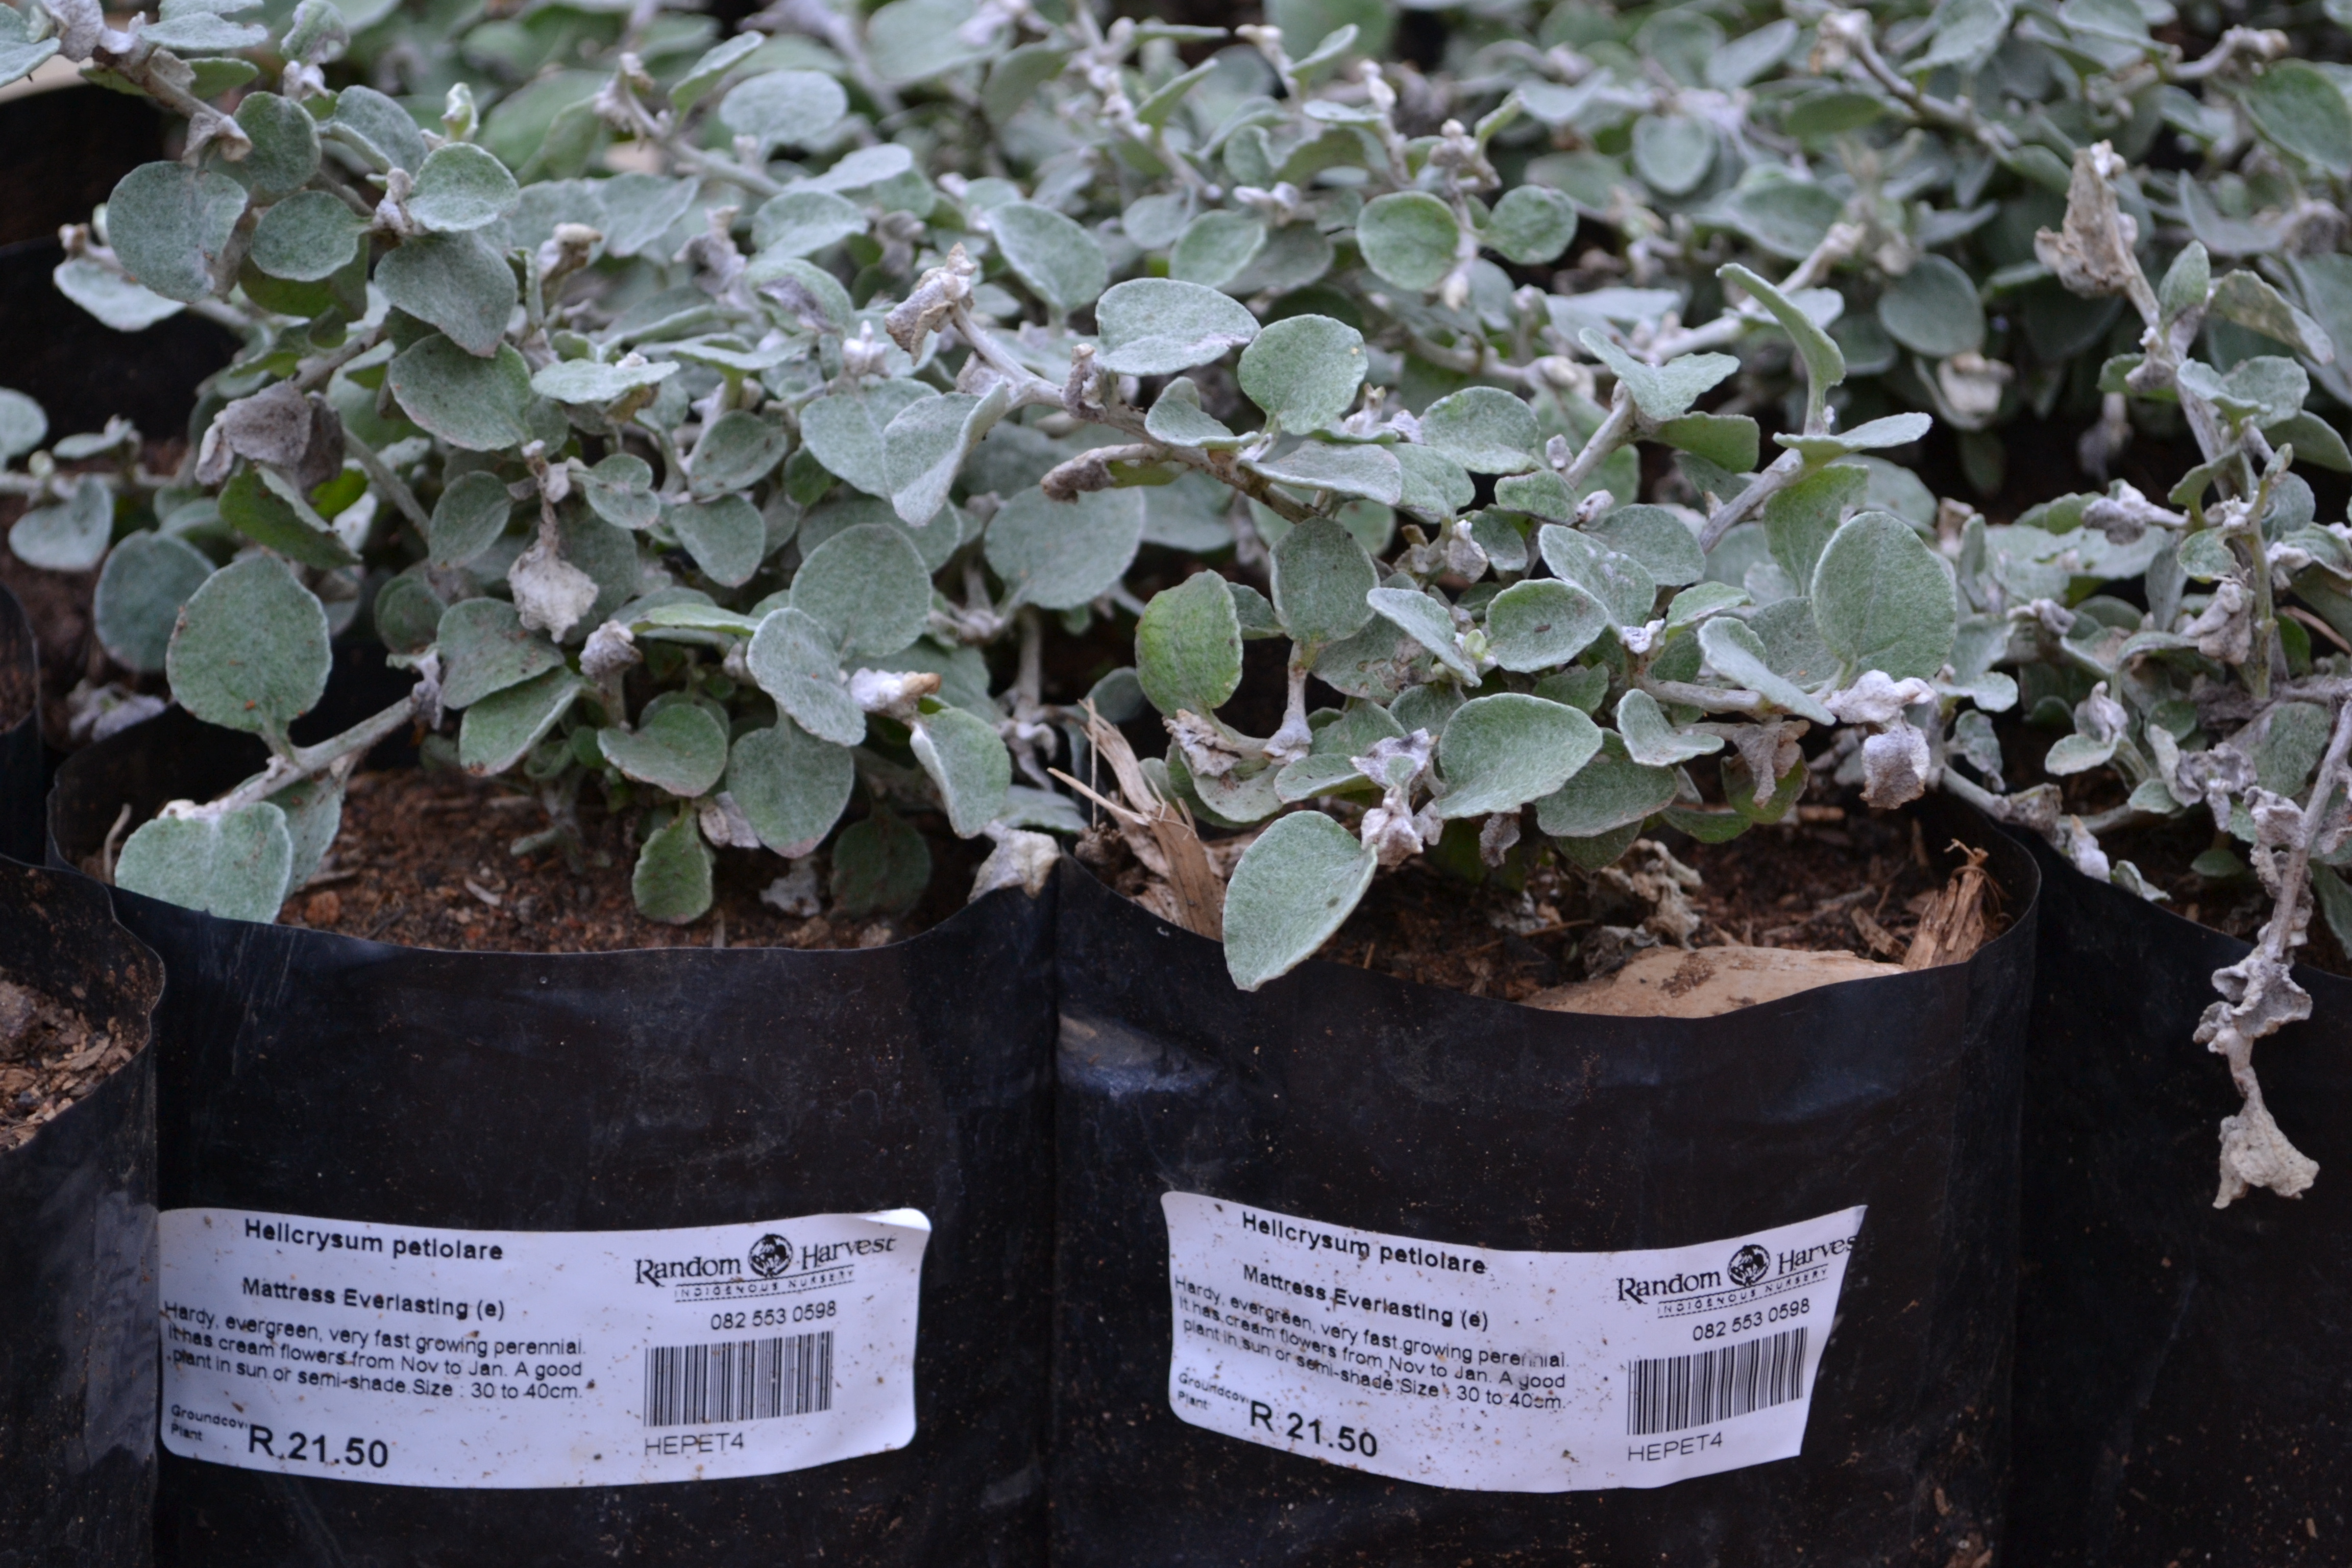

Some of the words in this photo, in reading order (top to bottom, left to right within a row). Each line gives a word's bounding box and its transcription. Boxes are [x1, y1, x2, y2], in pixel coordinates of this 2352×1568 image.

[634, 1254, 742, 1288] Random
[801, 1236, 897, 1270] Harvest
[1617, 1270, 1722, 1305] Random
[1778, 1235, 1858, 1275] Harves
[242, 1278, 335, 1304] Mattress
[344, 1289, 469, 1320] Everlasting
[477, 1299, 505, 1321] (e)
[674, 1282, 779, 1298] INDIGENOUS
[1243, 1264, 1327, 1301] Mattress
[1333, 1287, 1454, 1328] Everlasting
[1461, 1308, 1489, 1332] (e)
[1658, 1289, 1756, 1313] INDIGENOUS
[710, 1312, 746, 1330] 082
[751, 1307, 787, 1326] 553
[793, 1300, 837, 1322] 0598
[1693, 1321, 1726, 1341] 082
[1731, 1312, 1762, 1333] 553
[1769, 1297, 1810, 1323] 0598
[181, 1327, 213, 1348] has
[218, 1336, 275, 1357] cream
[281, 1344, 346, 1365] flowers
[351, 1351, 394, 1371] from
[401, 1357, 439, 1374] Nov
[445, 1360, 461, 1375] to
[469, 1362, 508, 1377] Jan.
[514, 1361, 529, 1377] A
[535, 1362, 582, 1381] good
[329, 1328, 369, 1349] very
[375, 1330, 410, 1349] fast
[416, 1336, 488, 1358] growing
[494, 1338, 586, 1358] perennial.
[1184, 1319, 1220, 1341] plant
[1223, 1330, 1237, 1346] in
[1242, 1336, 1270, 1356] sun
[1275, 1348, 1291, 1362] or
[1457, 1386, 1479, 1402] 30
[1486, 1390, 1503, 1405] to
[1192, 1299, 1220, 1321] has
[1226, 1314, 1275, 1338] cream
[1280, 1329, 1337, 1358] flowers
[1343, 1347, 1383, 1368] from
[1389, 1355, 1425, 1375] Nov
[1431, 1363, 1448, 1378] to
[1454, 1366, 1492, 1383] Jan.
[1499, 1371, 1512, 1386] A
[1321, 1323, 1358, 1346] very
[1363, 1328, 1398, 1350] fast
[1403, 1339, 1473, 1364] growing
[216, 1356, 231, 1372] in
[236, 1362, 267, 1379] sun
[273, 1368, 291, 1382] or
[471, 1382, 495, 1399] 30
[502, 1384, 518, 1399] to
[523, 1383, 582, 1399] 40cm.
[1178, 1372, 1249, 1404] Groundcov
[171, 1404, 249, 1430] Groundcov
[1178, 1391, 1209, 1410] Plant
[170, 1423, 203, 1441] Plant
[248, 1425, 276, 1457] R
[287, 1431, 389, 1469] 21.50
[645, 1431, 744, 1456] HEPET4
[1251, 1400, 1274, 1431] R
[1286, 1412, 1378, 1458] 21.50
[1628, 1432, 1723, 1461] HEPET4
